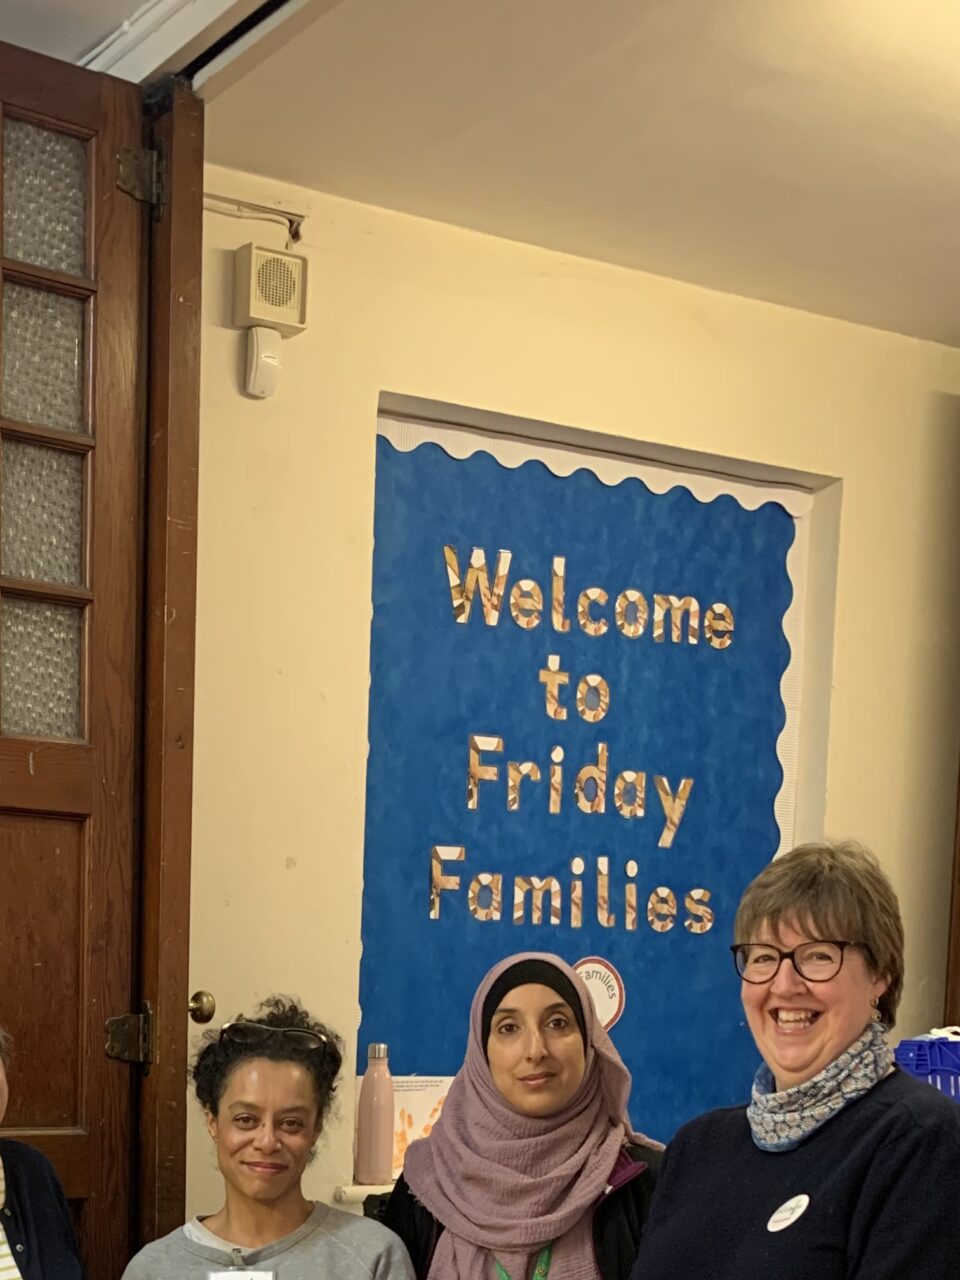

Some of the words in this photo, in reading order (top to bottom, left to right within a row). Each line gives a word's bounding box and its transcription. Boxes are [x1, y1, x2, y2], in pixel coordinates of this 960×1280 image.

[444, 544, 735, 650] Welcome
[539, 654, 610, 724] to
[467, 734, 694, 848] Friday
[429, 845, 715, 935] Families
[579, 970, 617, 1000] amilies
